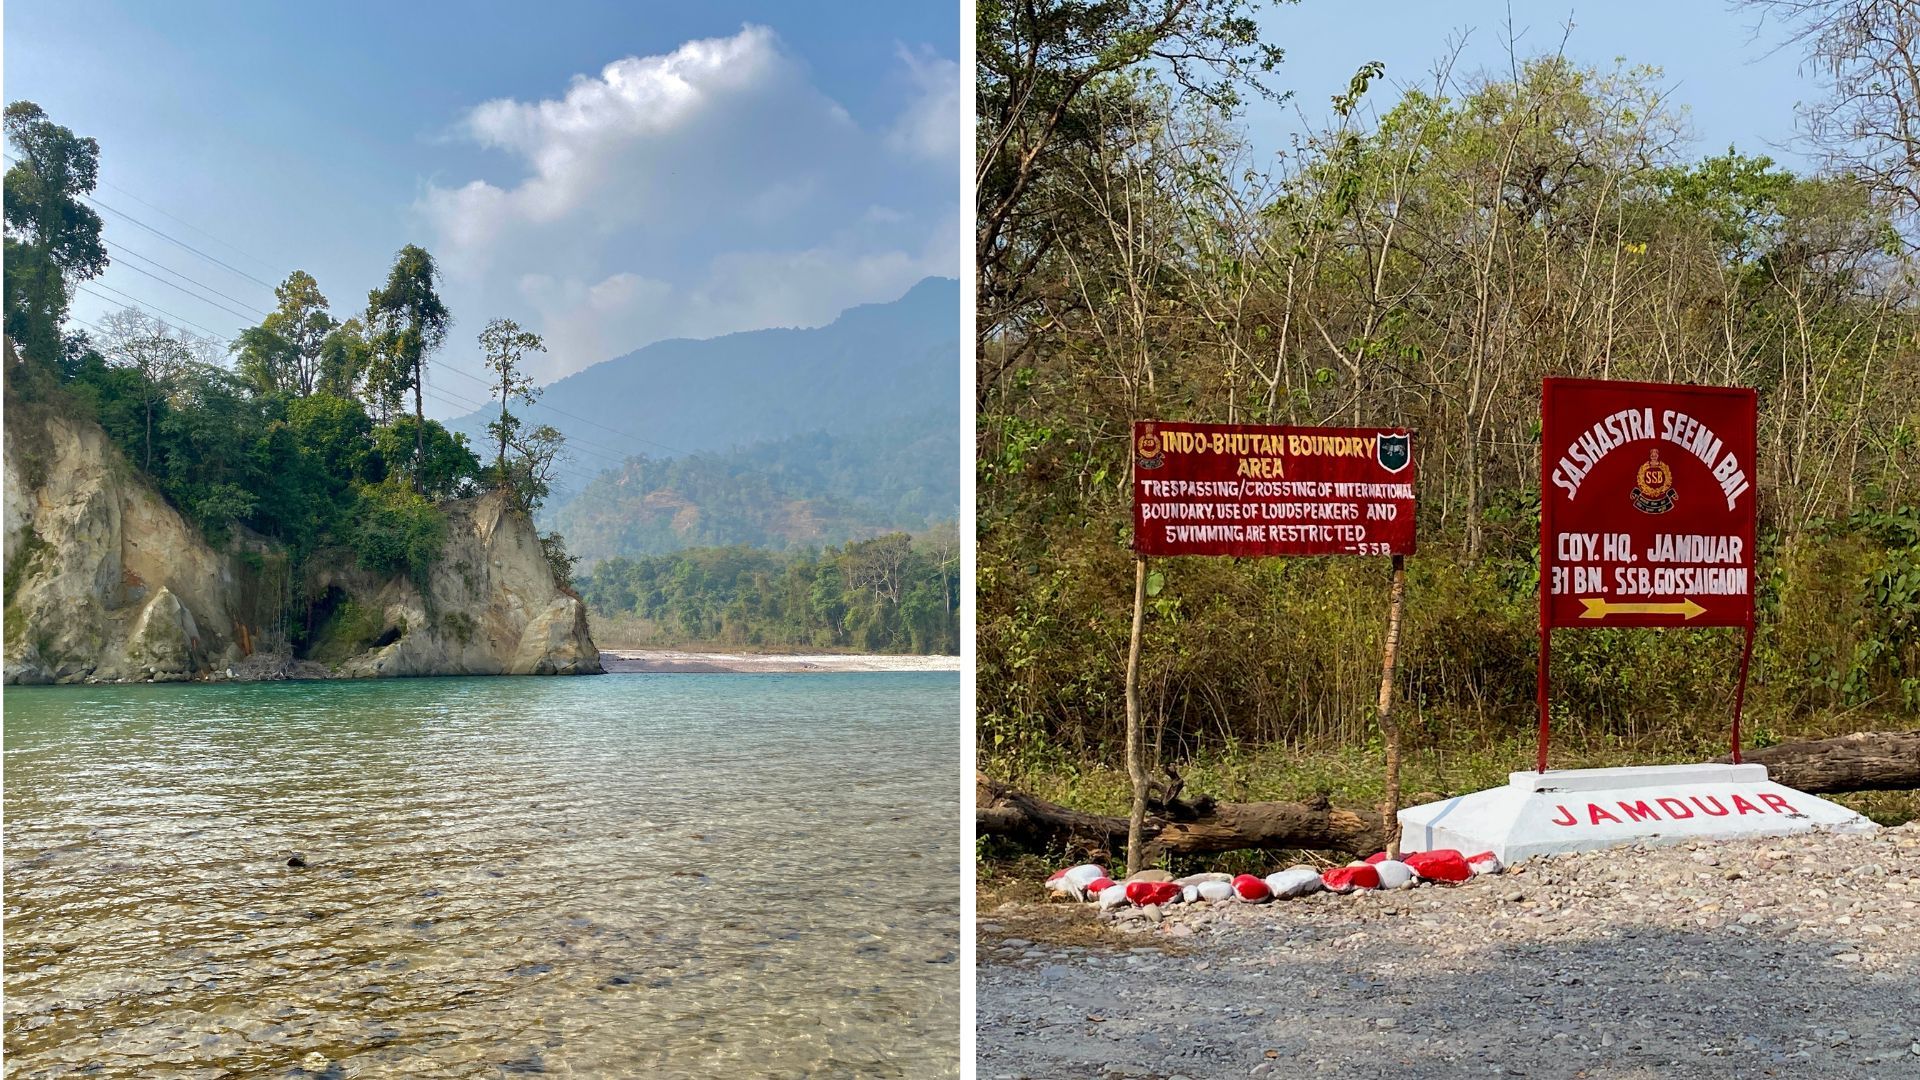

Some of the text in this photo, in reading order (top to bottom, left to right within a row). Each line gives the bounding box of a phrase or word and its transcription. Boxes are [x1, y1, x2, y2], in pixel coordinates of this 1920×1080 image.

[1160, 431, 1376, 459] INDO-BHUTAN BOUNDARY
[1237, 457, 1285, 479] AREA
[1552, 408, 1750, 512] SASHASTRA SEEMA BAL
[1645, 471, 1663, 484] SSB
[1317, 482, 1333, 498] OF
[1334, 482, 1415, 499] INTERNATIONAL
[1141, 502, 1397, 521] BOUNDARY, USE OF LOUDSPEAKERS AND
[1165, 524, 1366, 543] SWIMMING ARE RESTRICTED
[1558, 533, 1743, 564] COY. HQ. JAMDUAR
[1551, 566, 1569, 595] 31
[1574, 566, 1608, 594] BN.
[1552, 793, 1799, 826] JAMDUAR
